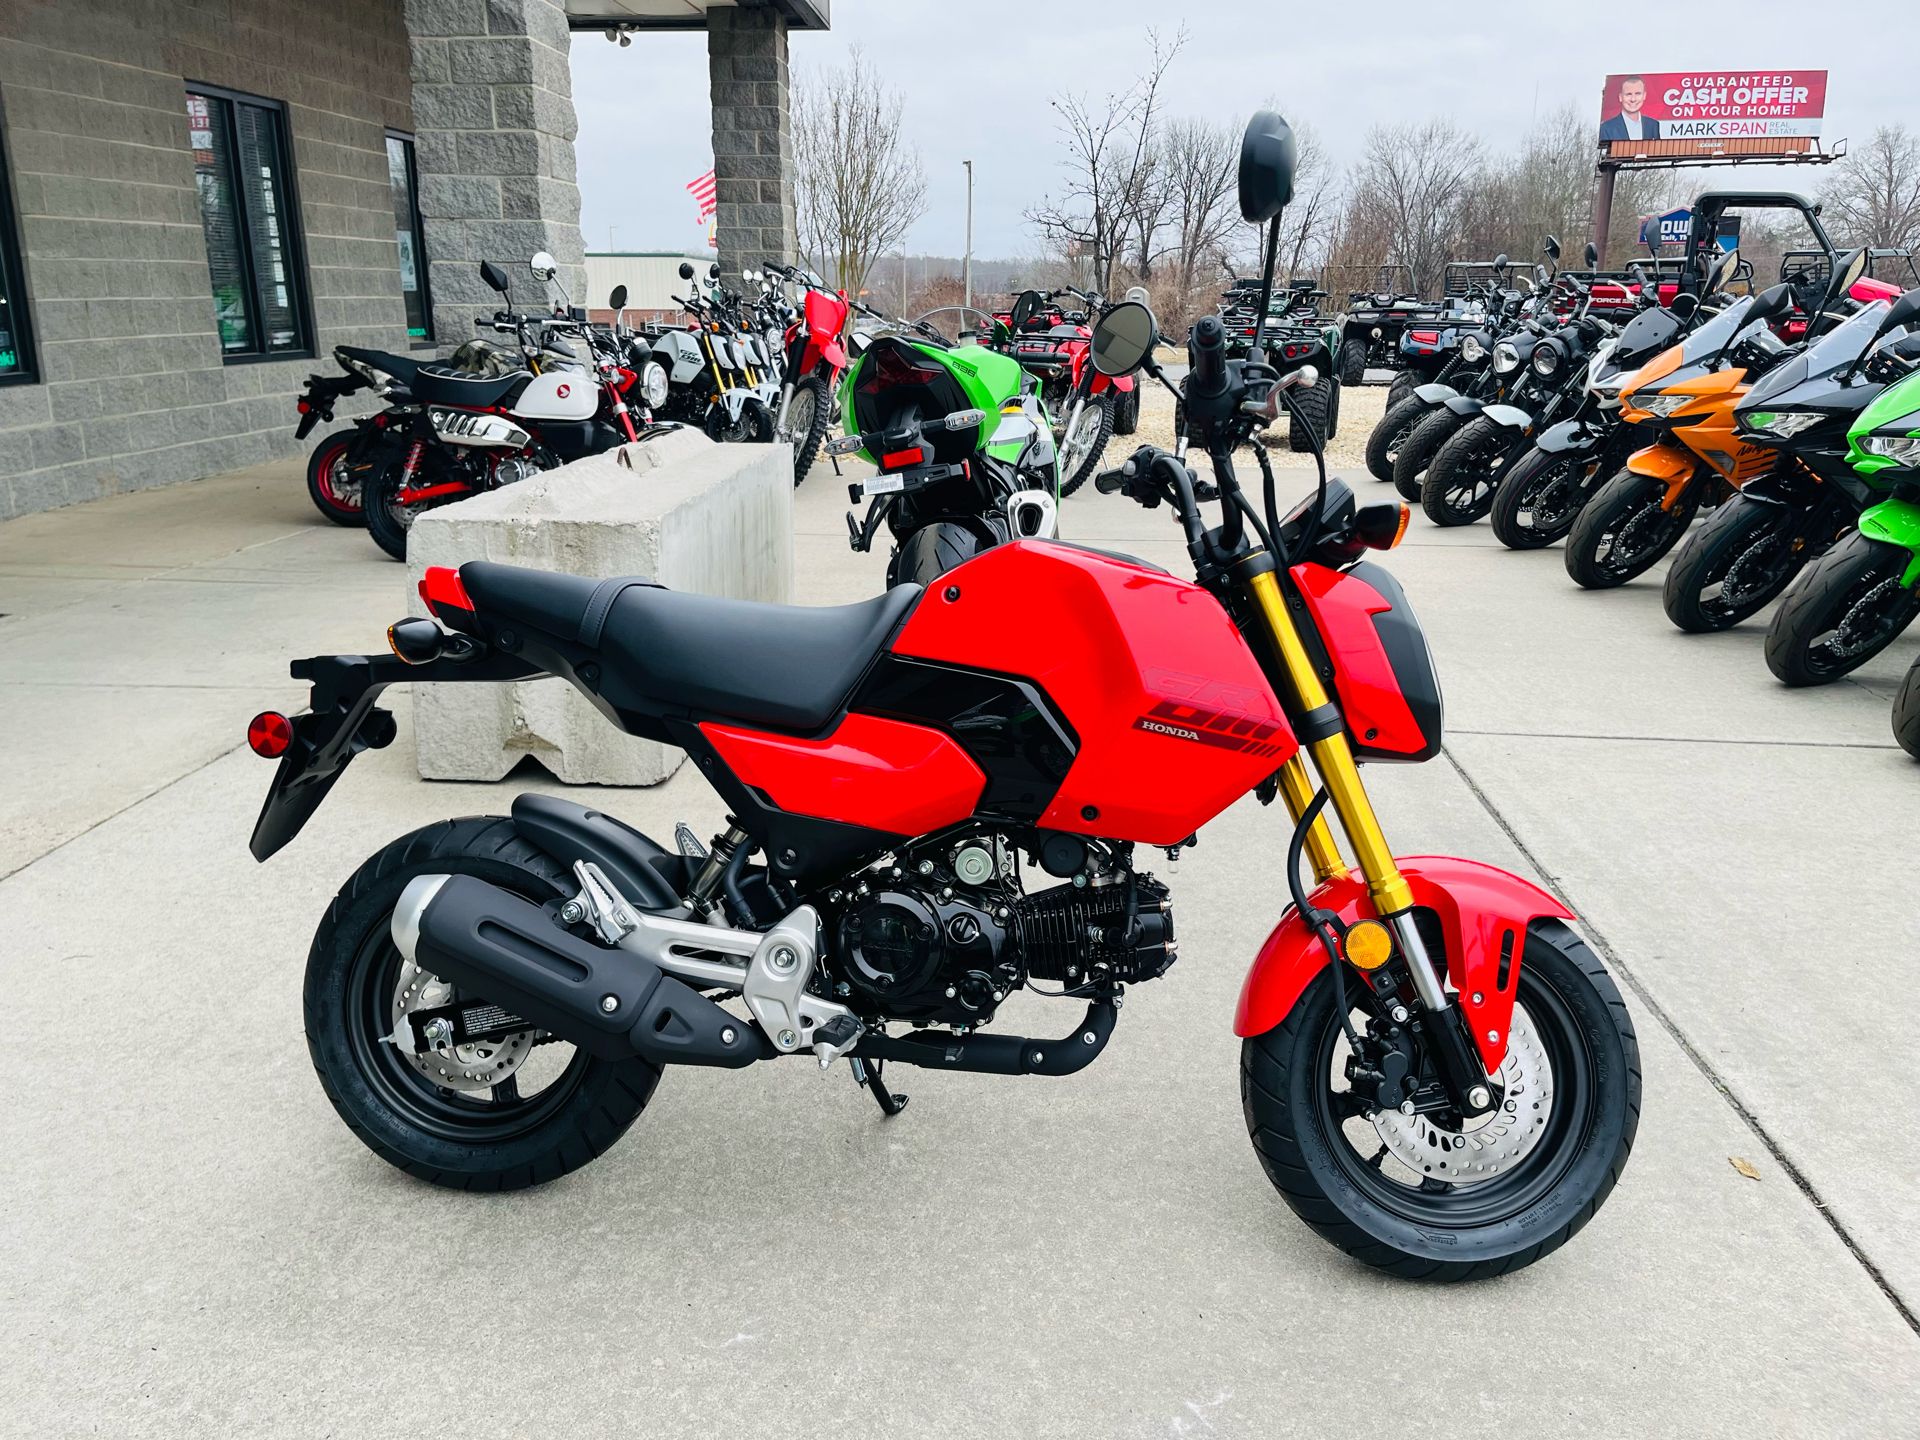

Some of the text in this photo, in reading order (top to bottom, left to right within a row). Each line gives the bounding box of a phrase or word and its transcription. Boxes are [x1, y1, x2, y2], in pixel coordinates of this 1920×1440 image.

[1681, 75, 1793, 87] GUARANTEED
[1663, 86, 1809, 106] CASH OFFER
[1672, 104, 1796, 117] ON YOUR HOME!
[1670, 121, 1768, 136] MARK SPAIN
[1141, 720, 1200, 741] HONDA
